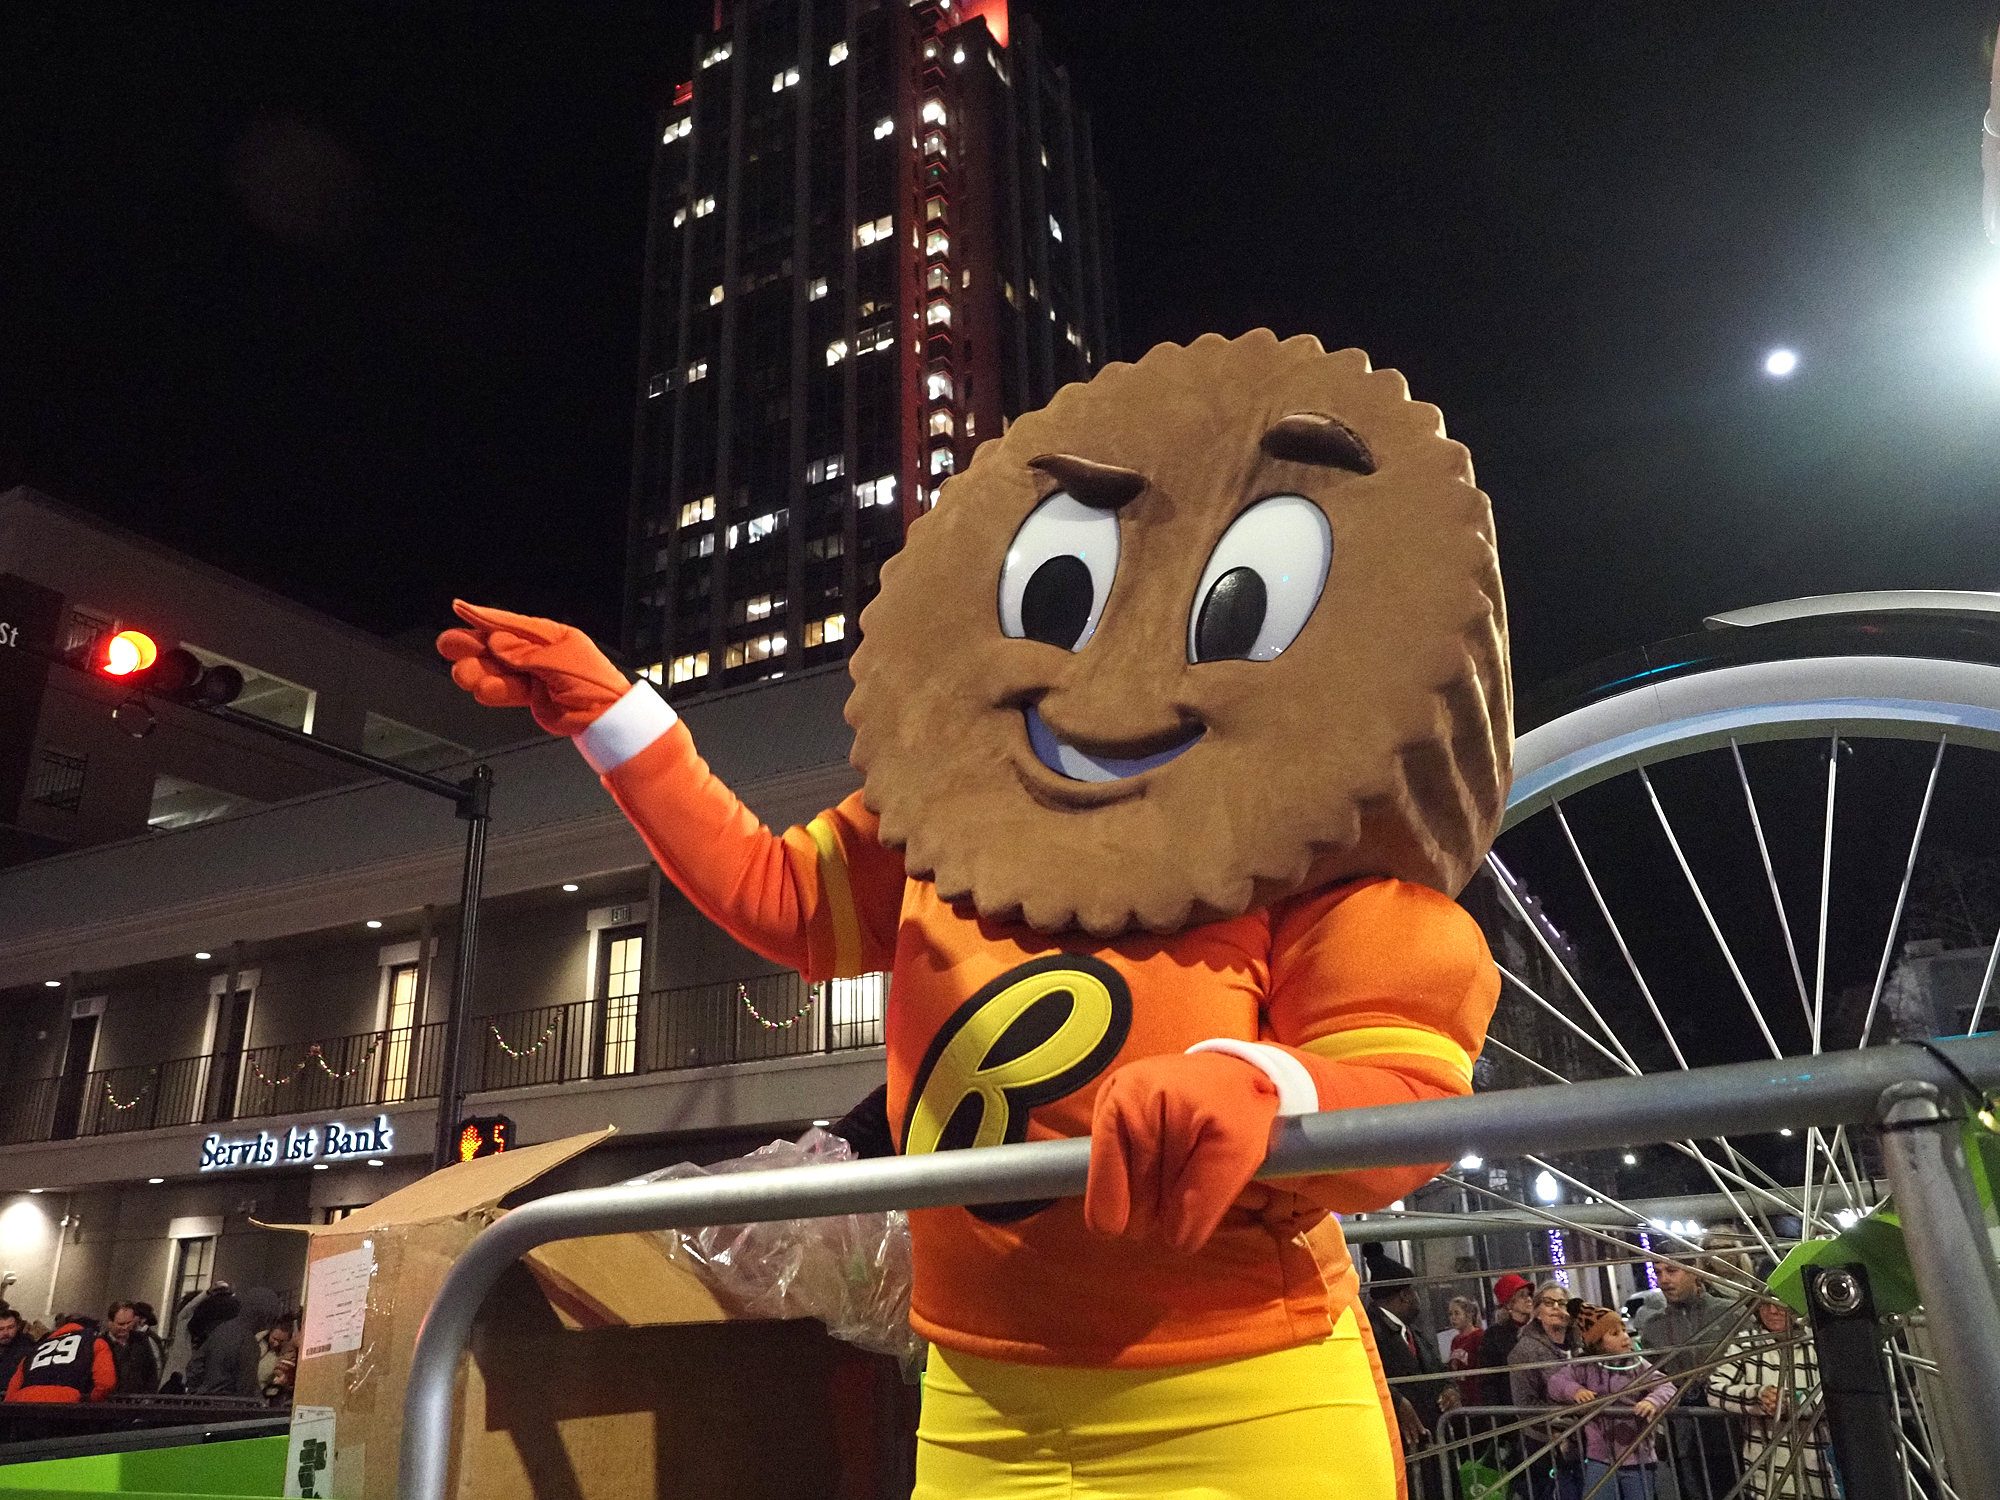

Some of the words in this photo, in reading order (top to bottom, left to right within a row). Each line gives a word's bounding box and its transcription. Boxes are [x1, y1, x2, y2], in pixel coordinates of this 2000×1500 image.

[0, 622, 19, 648] St
[321, 1114, 391, 1157] Bank
[493, 1124, 506, 1155] 5
[30, 1334, 82, 1371] 29
